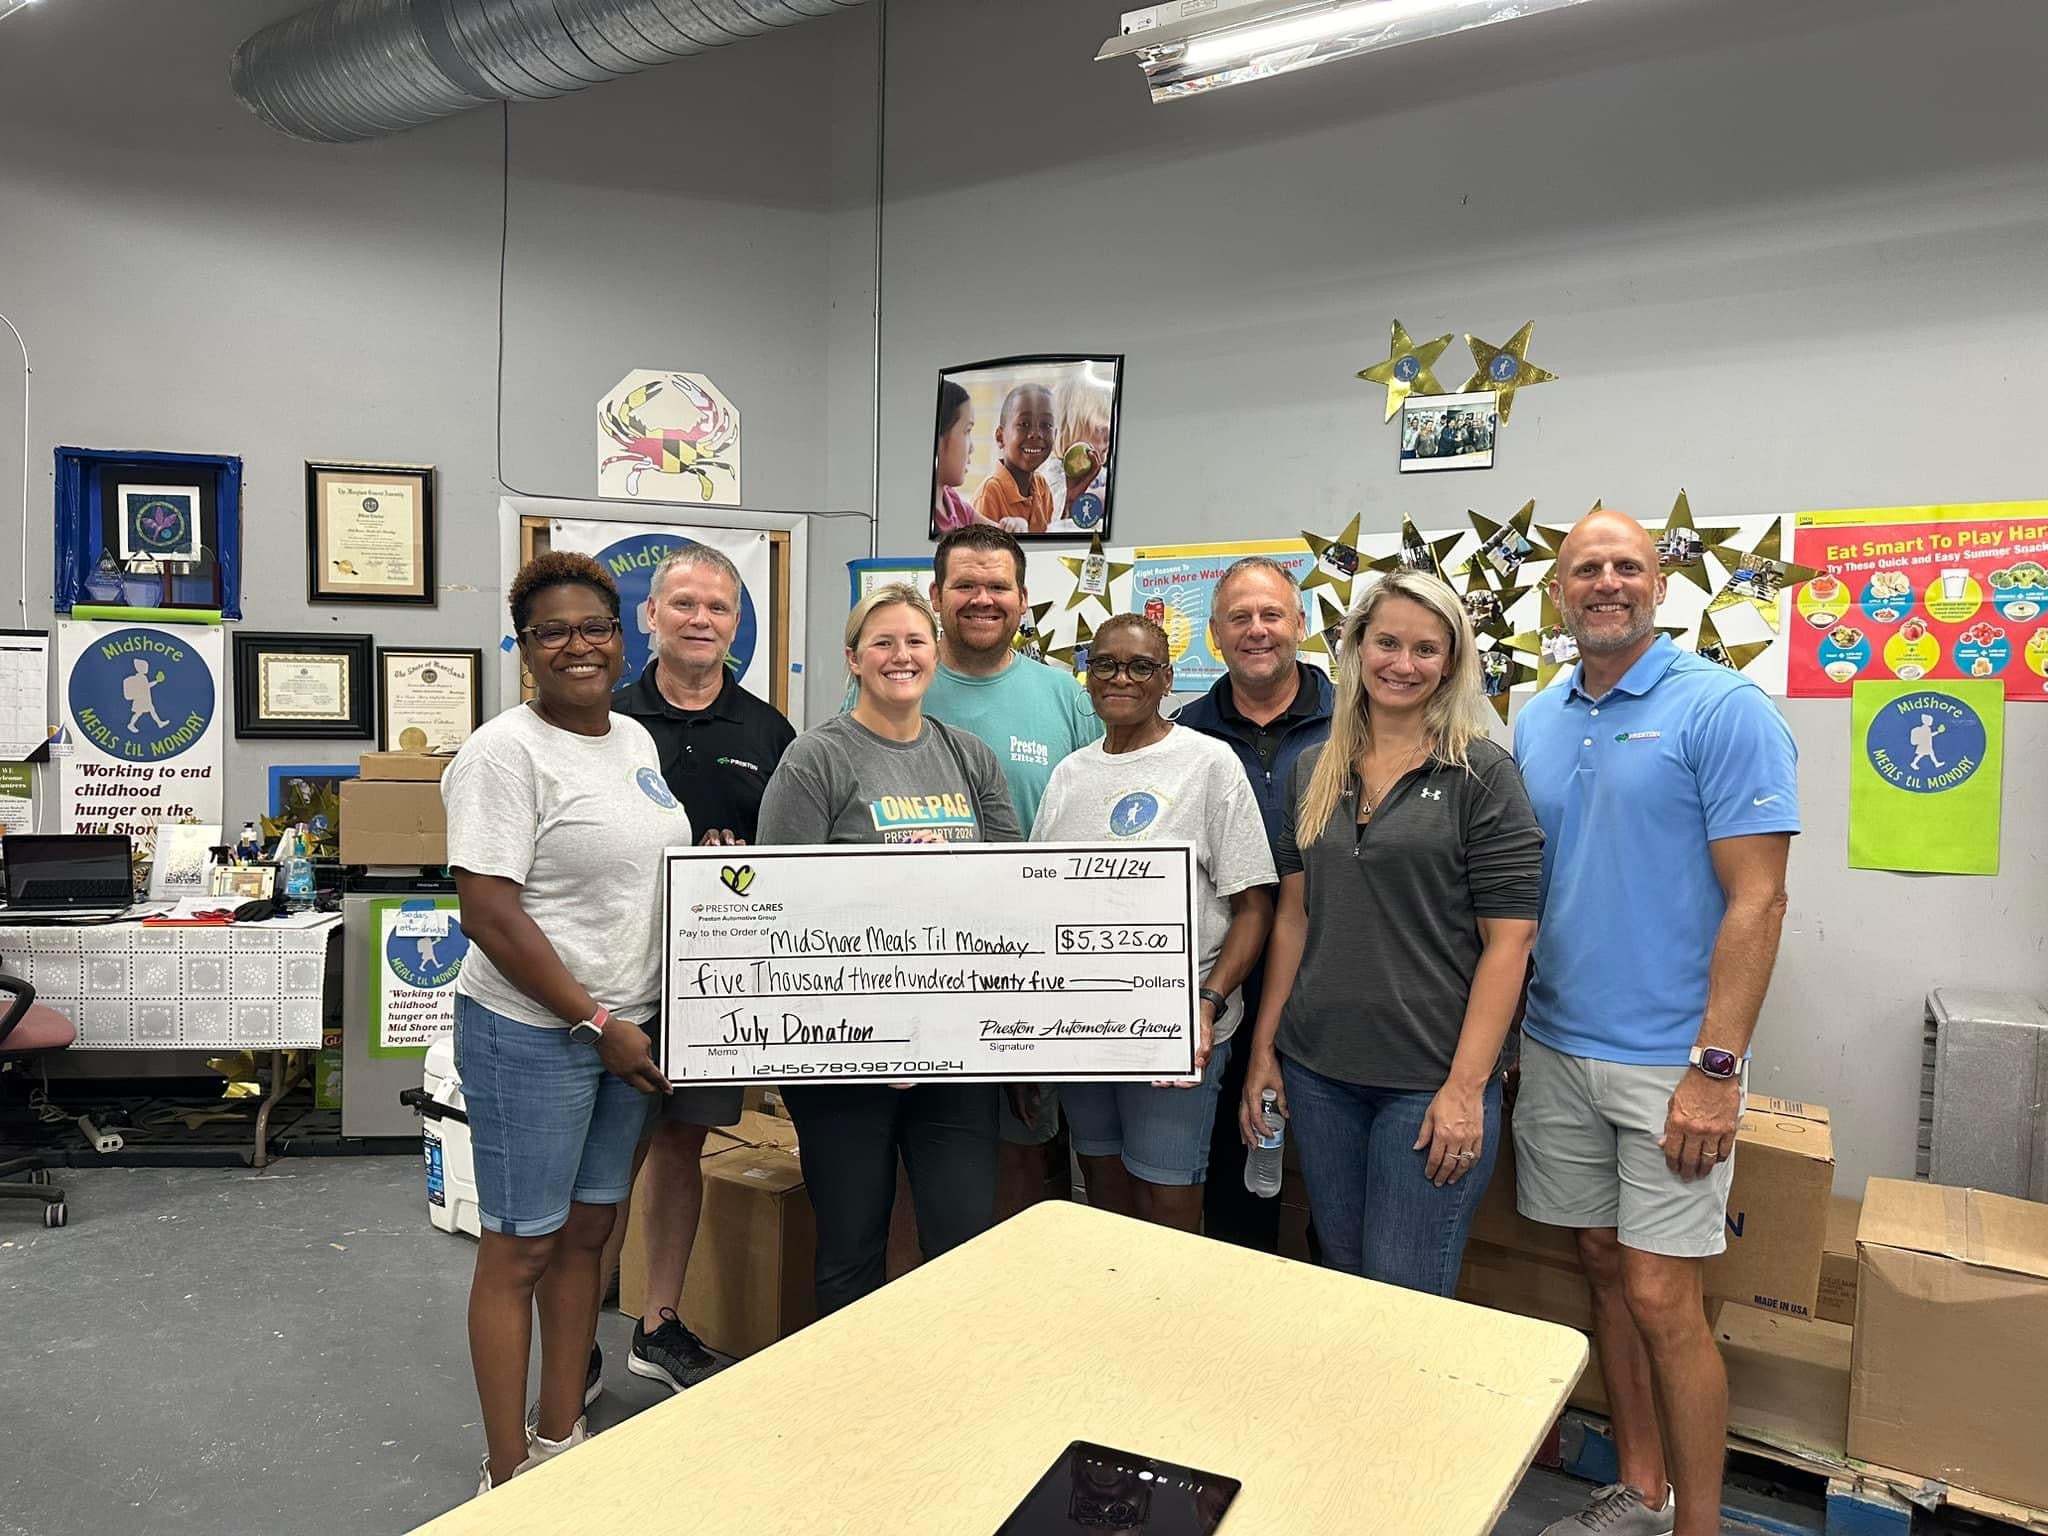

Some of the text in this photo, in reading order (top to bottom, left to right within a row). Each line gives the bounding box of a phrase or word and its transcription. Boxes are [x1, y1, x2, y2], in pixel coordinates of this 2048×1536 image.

[1826, 526, 2048, 560] Eat Smart To Play Har
[608, 544, 672, 578] MidS
[1826, 542, 2048, 574] Try These Quick and Easy Summer Snack
[1142, 576, 1170, 588] Drink
[1172, 573, 1196, 584] More
[101, 636, 184, 662] MidShore
[1896, 696, 1963, 718] MidShore
[78, 708, 120, 750] MEALS
[152, 710, 205, 756] MONDAY
[1010, 736, 1048, 757] Preston
[159, 766, 176, 778] to
[180, 766, 212, 778] end
[1872, 748, 1904, 781] MEALS
[1927, 756, 1975, 790] MONDAY
[74, 784, 162, 797] childhood
[74, 803, 194, 819] hunger on the
[884, 830, 914, 844] PREST
[955, 826, 974, 840] 2024
[1022, 857, 1152, 880] Date 7/24/24
[705, 903, 784, 912] PRESTON CARES
[722, 914, 757, 922] Automotive
[758, 914, 777, 922] Group
[679, 929, 698, 940] Pay
[712, 928, 727, 937] the
[730, 928, 758, 936] Order
[760, 928, 770, 936] of
[770, 927, 862, 954] MidShore
[866, 926, 917, 952] Meals
[922, 926, 947, 951] Til
[956, 929, 1030, 958] Monday
[1061, 929, 1168, 952] $5,325.00
[432, 958, 462, 985] MONDA
[690, 962, 744, 995] five
[750, 960, 845, 994] Thousand
[968, 970, 1026, 992] twenty
[1028, 970, 1065, 990] five
[1132, 976, 1186, 989] Dollars
[436, 990, 446, 998] to
[388, 1001, 438, 1009] childhood
[388, 1012, 423, 1022] hunger
[388, 1022, 452, 1032] Mid Shore an
[720, 1008, 874, 1050] July Donation
[979, 1018, 1182, 1038] Preston Automotive Group
[708, 1048, 738, 1057] Memo
[989, 1042, 1035, 1052] Signature
[1754, 1295, 1808, 1316] MADE IN USA
